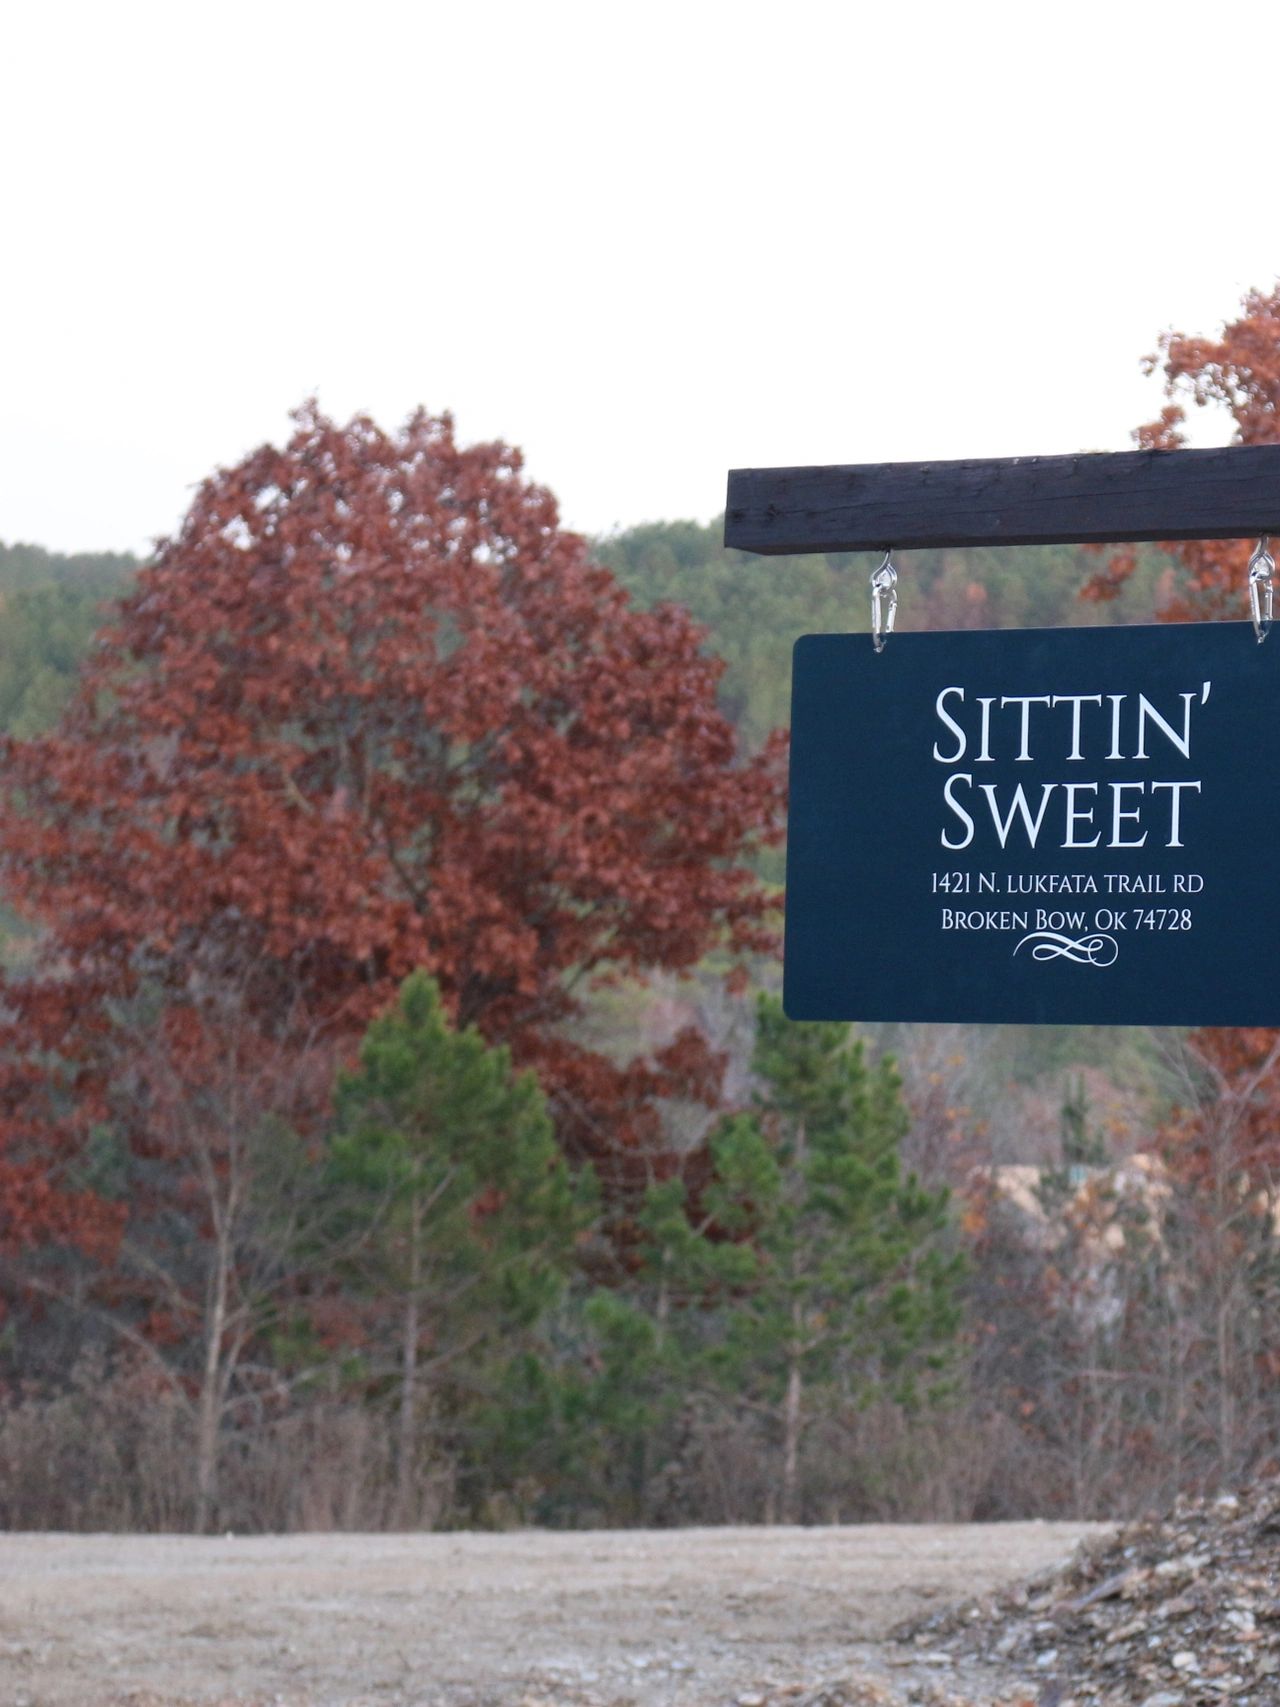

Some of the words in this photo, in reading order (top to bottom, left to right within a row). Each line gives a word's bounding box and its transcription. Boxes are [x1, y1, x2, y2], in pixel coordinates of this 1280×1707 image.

[940, 772, 1202, 850] SWEET
[931, 872, 970, 893] 1421
[978, 871, 1001, 893] N.
[1007, 875, 1099, 893] LUKFATA
[1103, 874, 1167, 893] TRAIL
[1172, 874, 1204, 893] RD
[941, 909, 1028, 930] BROKEN
[1035, 908, 1089, 932] BOW,
[1094, 908, 1128, 930] OK
[1132, 908, 1192, 930] 74728
